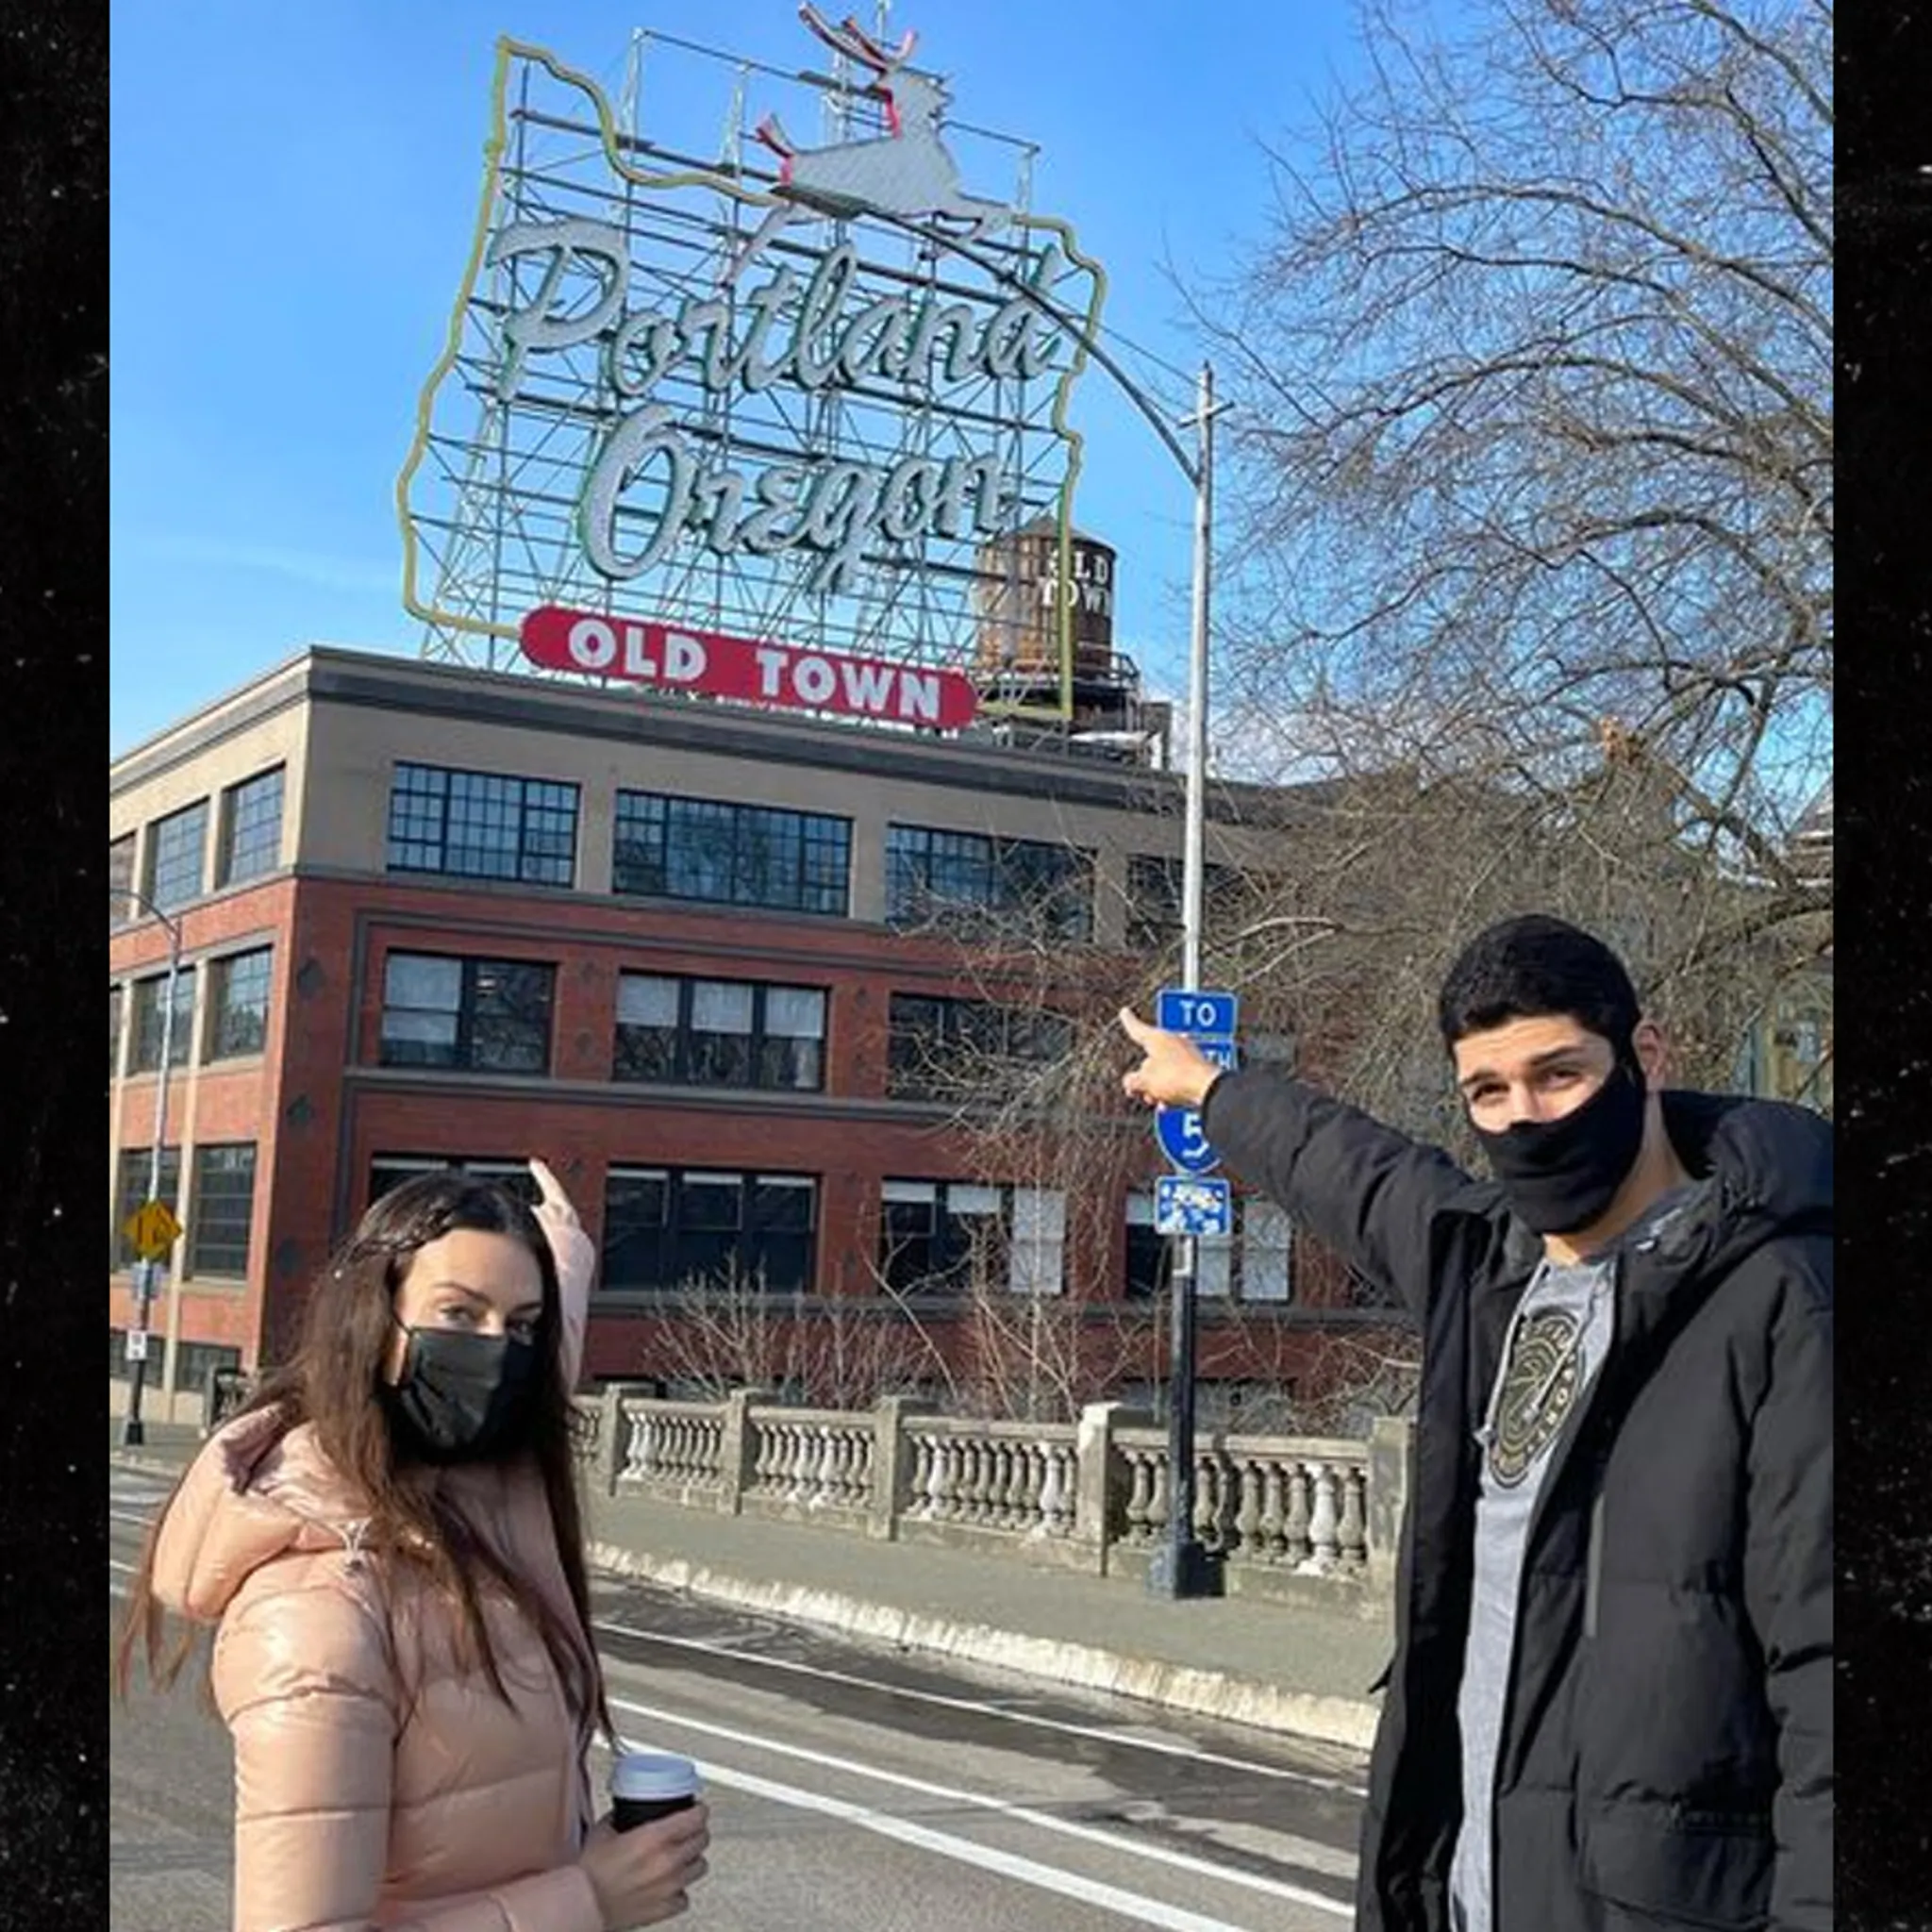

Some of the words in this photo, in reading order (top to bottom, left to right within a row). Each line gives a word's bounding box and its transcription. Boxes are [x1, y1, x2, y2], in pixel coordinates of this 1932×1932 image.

[486, 220, 1062, 403] Portland
[579, 404, 1021, 593] Oregon
[568, 619, 708, 681] OLD
[758, 649, 940, 720] TOWN
[1179, 1000, 1217, 1027] TO
[1182, 1114, 1211, 1159] 5
